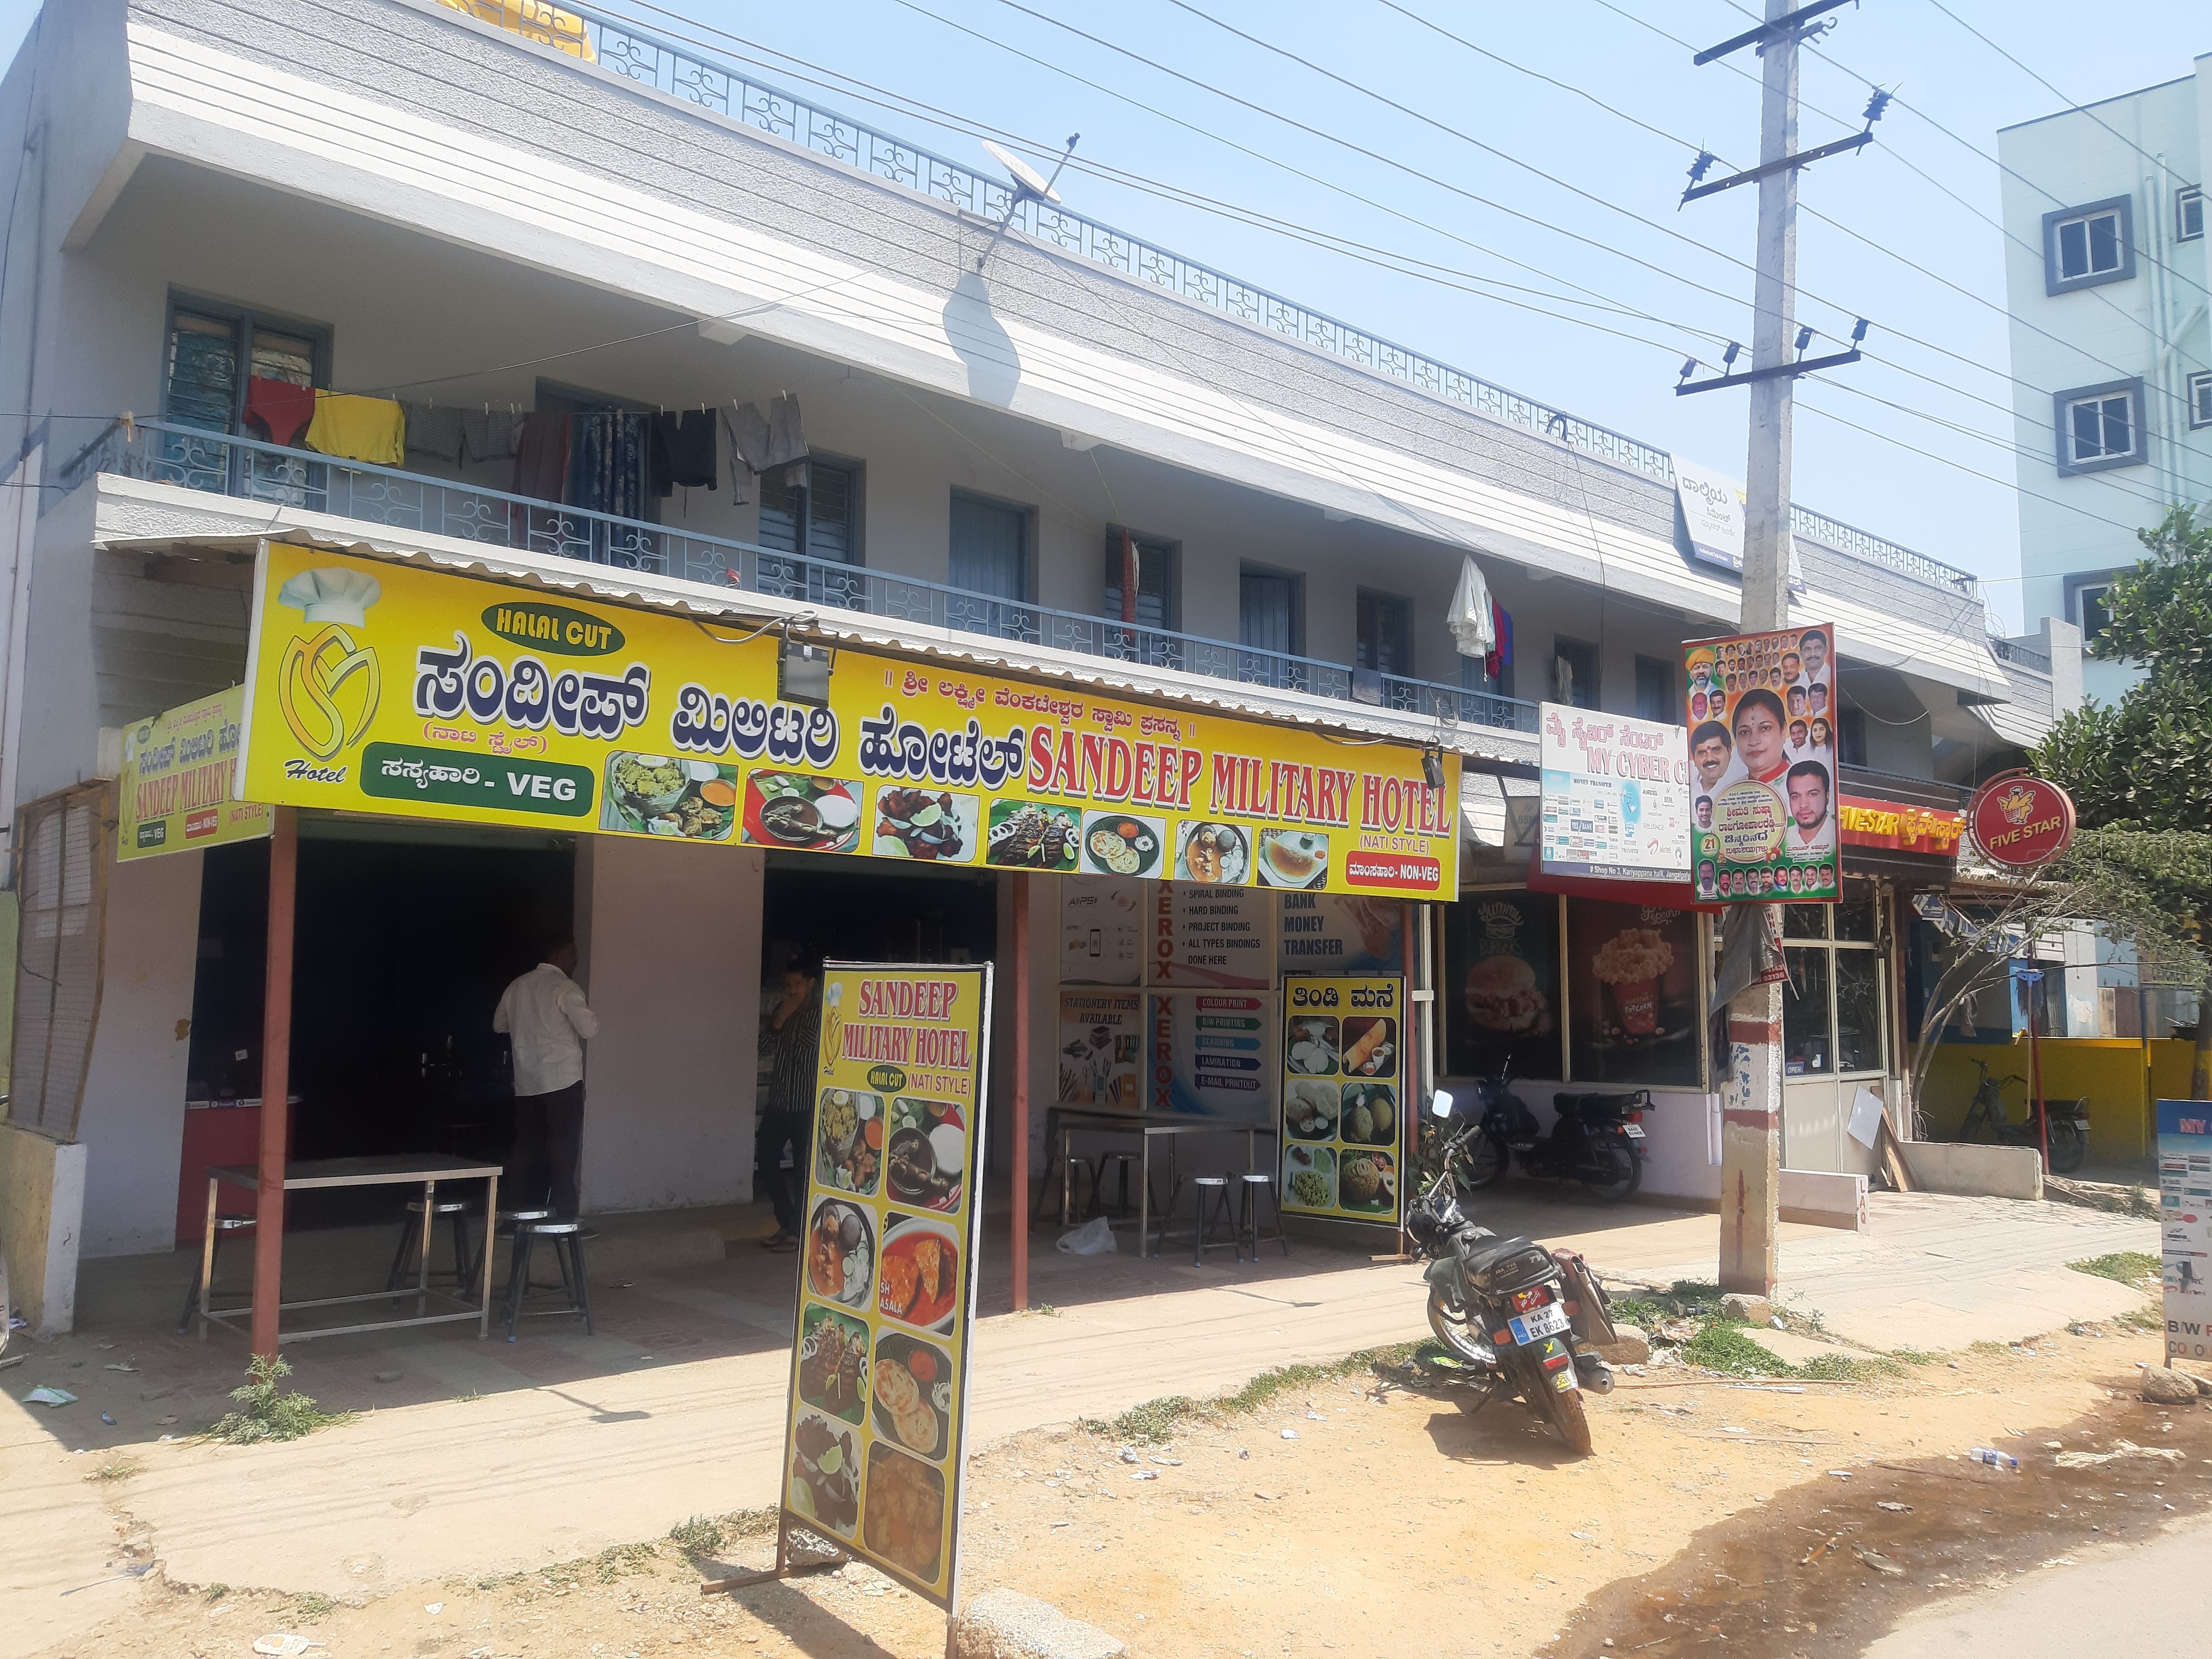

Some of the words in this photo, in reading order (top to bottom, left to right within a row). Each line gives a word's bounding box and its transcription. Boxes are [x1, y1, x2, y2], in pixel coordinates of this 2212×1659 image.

[496, 607, 562, 642] HALAL
[567, 621, 612, 650] CUT
[413, 630, 651, 741] ಸಂದೀಪ್
[671, 682, 839, 768] ಮಿಲಿಟರಿ
[860, 702, 1026, 791] ಹೋಟೆಲ್
[902, 670, 928, 696] ಶ್ರೀ
[1092, 705, 1133, 733] ಸ್ವಾಮಿ
[1141, 716, 1182, 741] ಪ್ರಸನ್ನ
[284, 759, 346, 784] Hotel
[1587, 746, 1612, 775] MY
[1616, 751, 1671, 783] CYBER
[507, 773, 576, 801] VEG
[1026, 722, 1202, 811] SANDEEP
[1209, 752, 1356, 827] MILITARY
[1361, 772, 1452, 839] HOTEL
[136, 774, 179, 822] SANDEEP
[180, 760, 227, 811] MILITARY
[1582, 822, 1592, 831] BANK
[1990, 830, 2020, 850] FIVE
[2023, 816, 2061, 838] STAR
[1359, 833, 1390, 853] (NATI
[1391, 836, 1429, 856] STYLE)
[1705, 838, 1715, 849] 21
[1399, 862, 1439, 882] NON-VEG
[1594, 866, 1607, 876] Shop
[1189, 889, 1213, 899] SPIRAL
[1215, 889, 1244, 899] BINDING
[1284, 894, 1316, 909] BANK
[1189, 906, 1208, 915] HARD
[1210, 906, 1238, 915] BINDING
[1189, 922, 1219, 932] PROJECT
[1221, 922, 1250, 931] BINDING
[1284, 916, 1324, 932] MONEY
[1188, 939, 1200, 948] ALL
[1202, 939, 1225, 948] TYPES
[1226, 939, 1260, 949] BINDINGS
[1284, 939, 1343, 955] TRANSFER
[1188, 956, 1206, 964] DONE
[1209, 956, 1227, 964] HERE
[859, 979, 958, 1022] SANDEEP
[1064, 998, 1112, 1010] STATIONERY
[1114, 999, 1140, 1010] ITEMS
[1203, 998, 1227, 1007] COLOUR
[1228, 999, 1247, 1008] PRINT
[1292, 987, 1339, 1008] ತಿಂಡಿ
[1350, 983, 1394, 1009] ಮನೆ
[1079, 1014, 1122, 1025] AVAILABLE
[1216, 1019, 1245, 1027] PRINTING
[841, 1022, 913, 1065] MILITARY
[914, 1027, 972, 1072] HOTEL
[1202, 1038, 1234, 1047] SCANNING
[1155, 996, 1173, 1107] XEROX
[1202, 1057, 1240, 1068] LAMINATION
[1788, 1065, 1801, 1074] OPEN
[870, 1071, 888, 1085] HALAL
[889, 1074, 903, 1087] CUT
[908, 1072, 933, 1092] (NATI
[935, 1076, 971, 1100] STYLE)
[1201, 1077, 1223, 1086] E-MAIL
[1225, 1079, 1256, 1089] PRINTOUT
[2180, 1118, 2206, 1134] MY
[879, 1298, 902, 1315] ASALA
[1530, 1314, 1543, 1323] KA
[1544, 1310, 1553, 1318] 27
[1529, 1326, 1544, 1338] EK
[1544, 1318, 1564, 1333] 8623
[2168, 1320, 2200, 1335] B/W
